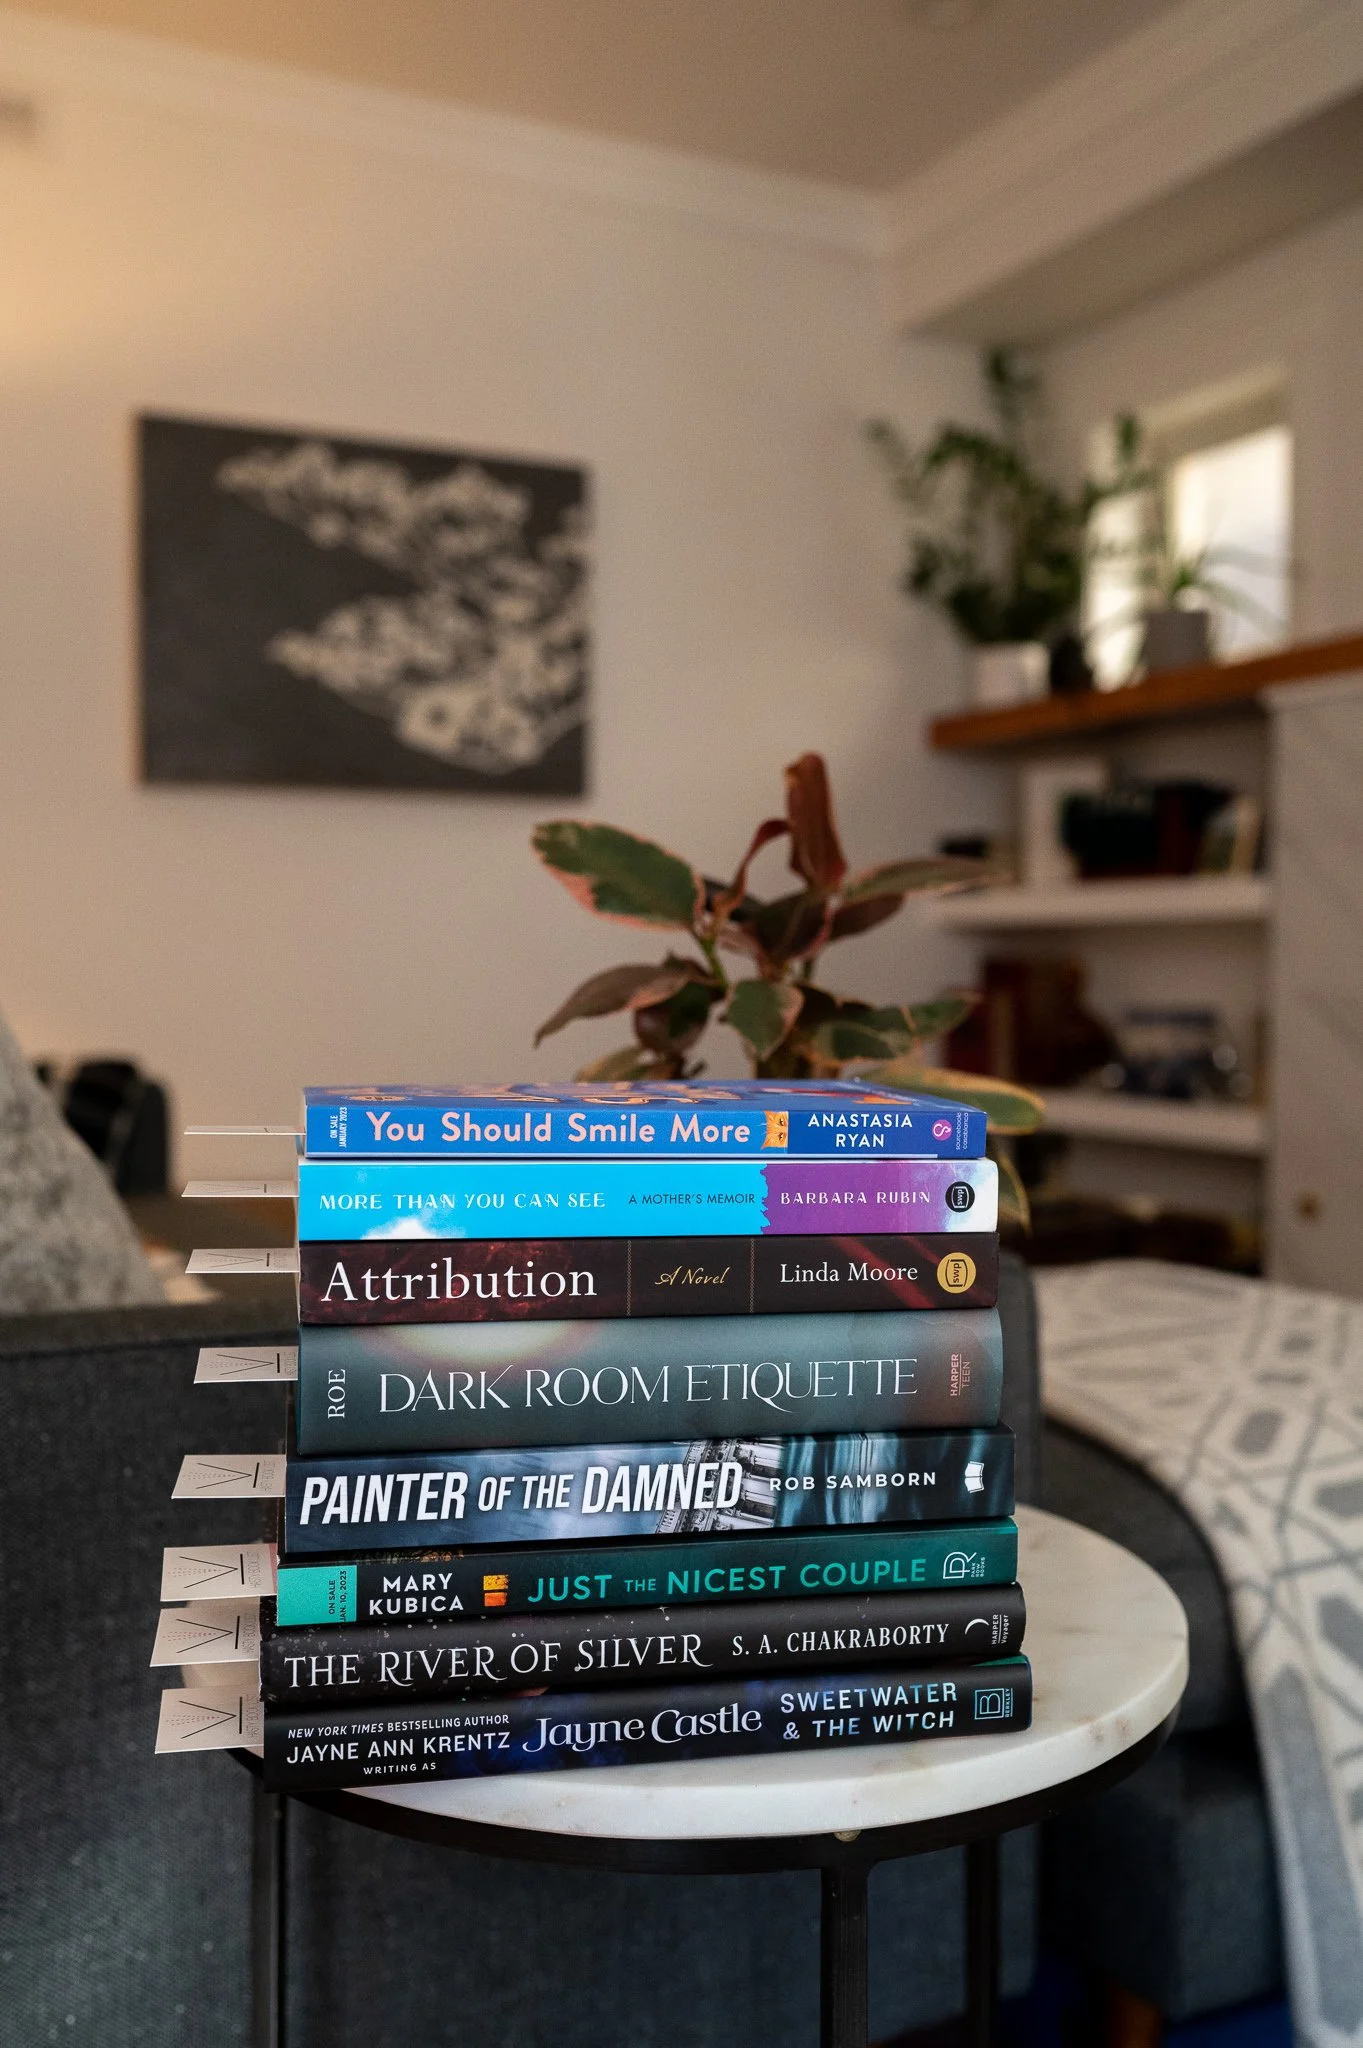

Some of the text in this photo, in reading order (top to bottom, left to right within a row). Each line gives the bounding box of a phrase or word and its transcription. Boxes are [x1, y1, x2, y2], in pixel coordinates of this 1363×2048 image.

[330, 1115, 338, 1139] ON SALE
[339, 1107, 347, 1148] JANUARY 2023
[366, 1111, 750, 1143] You Should Smile More
[808, 1113, 913, 1128] ANASTASIA
[835, 1133, 885, 1148] RYAN
[319, 1192, 606, 1210] MORE THAN YOU CAN SEE
[628, 1194, 755, 1205] A MOTHER'S MEMOIR
[780, 1191, 931, 1205] BARBARA RUBIN
[957, 1189, 965, 1205] swp
[321, 1257, 598, 1302] Attribution
[655, 1266, 731, 1286] A Novel
[780, 1262, 918, 1283] Linda Moore
[952, 1262, 963, 1284] swp
[379, 1358, 918, 1413] DARK ROOM ETIQUETTE
[950, 1353, 959, 1397] HARPER
[962, 1361, 971, 1389] TEEN
[327, 1368, 346, 1419] ROE
[299, 1471, 469, 1525] PAINTER
[478, 1476, 515, 1511] OF
[522, 1474, 574, 1509] THE
[581, 1461, 743, 1514] DAMNED
[769, 1471, 937, 1492] ROB SAMBORN
[383, 1573, 453, 1593] MARY
[527, 1558, 927, 1603] JUST THE NICEST COUPLE
[329, 1602, 336, 1615] ON
[339, 1570, 348, 1622] JAN. 10, 2023
[369, 1595, 464, 1616] KUBICA
[732, 1623, 950, 1656] S. A. CHAKRABORTY
[1001, 1614, 1009, 1644] Voyager
[284, 1633, 714, 1688] THE RIVER OF SILVER
[780, 1682, 957, 1713] SWEETWATER
[288, 1714, 510, 1739] NEW YORK TIMES BESTSELLING AUTHOR
[522, 1703, 762, 1753] Jayne Castle
[783, 1711, 954, 1740] & THE WITCH
[286, 1731, 511, 1764] JAYNE ANN KRENTZ
[363, 1762, 437, 1775] WRITING AS
